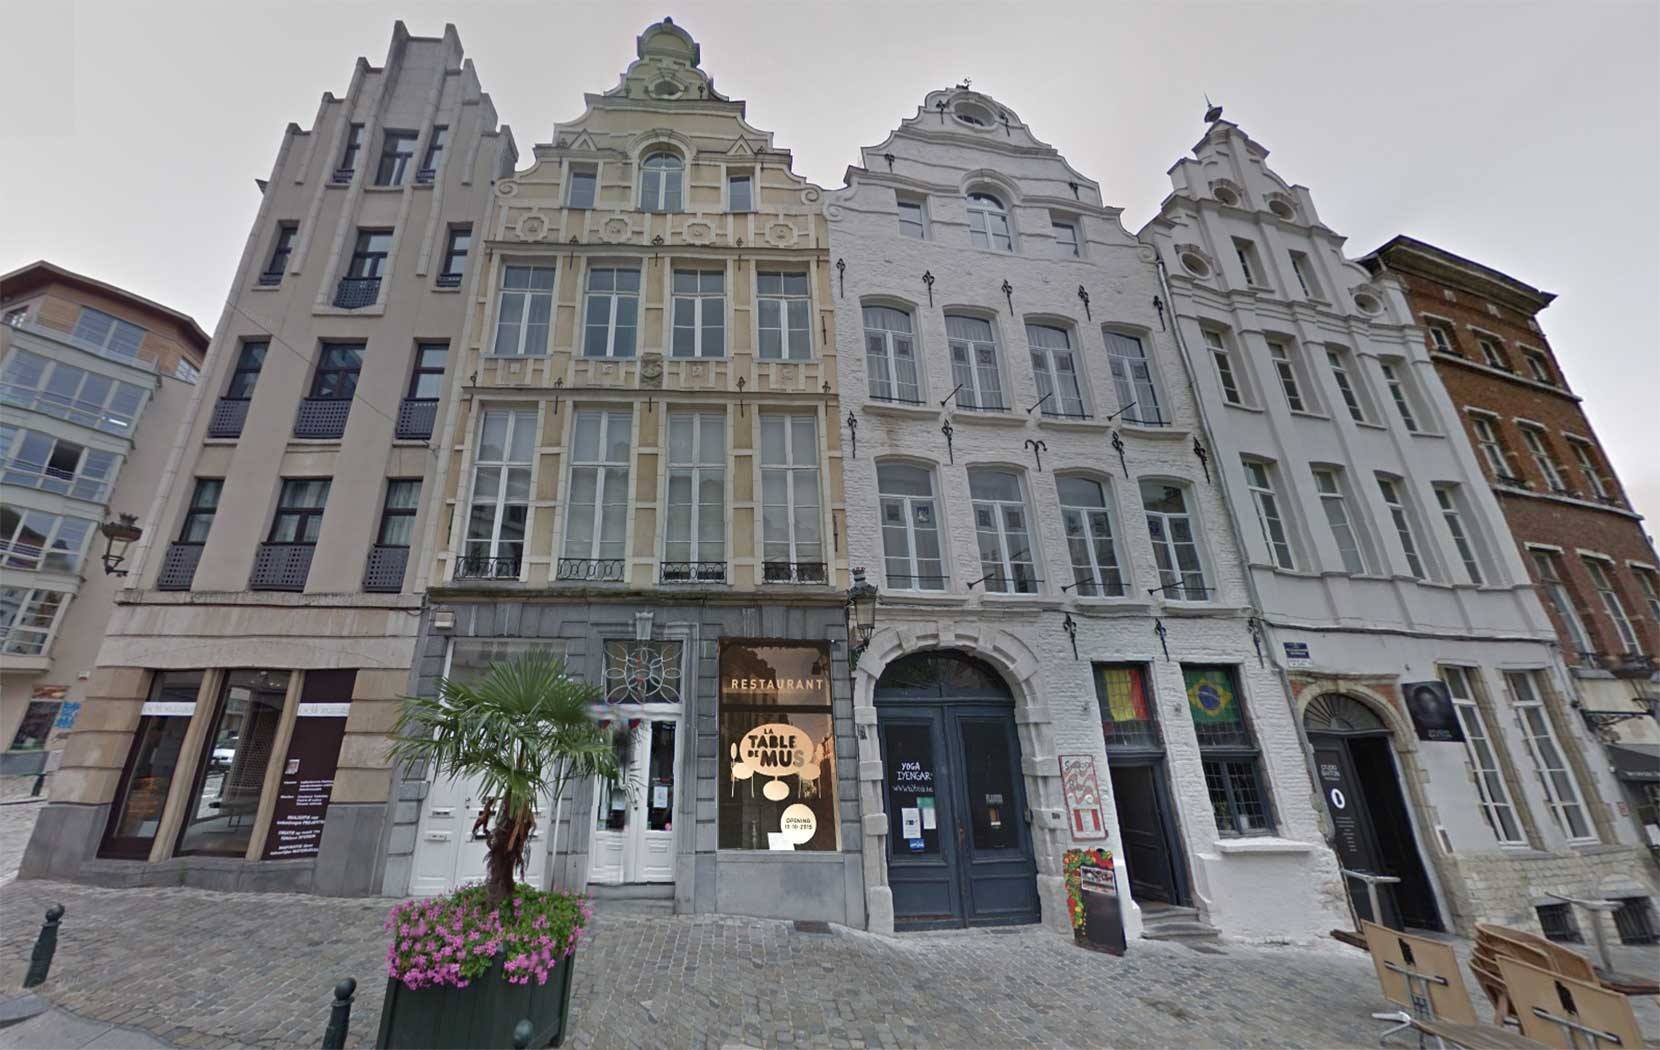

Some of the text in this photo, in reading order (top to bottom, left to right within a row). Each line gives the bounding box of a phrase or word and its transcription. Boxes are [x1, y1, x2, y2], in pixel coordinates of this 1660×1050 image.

[731, 679, 823, 689] RESTAURANT
[748, 735, 796, 749] TABLE
[747, 749, 804, 767] DE MUS
[901, 762, 920, 771] YOGA
